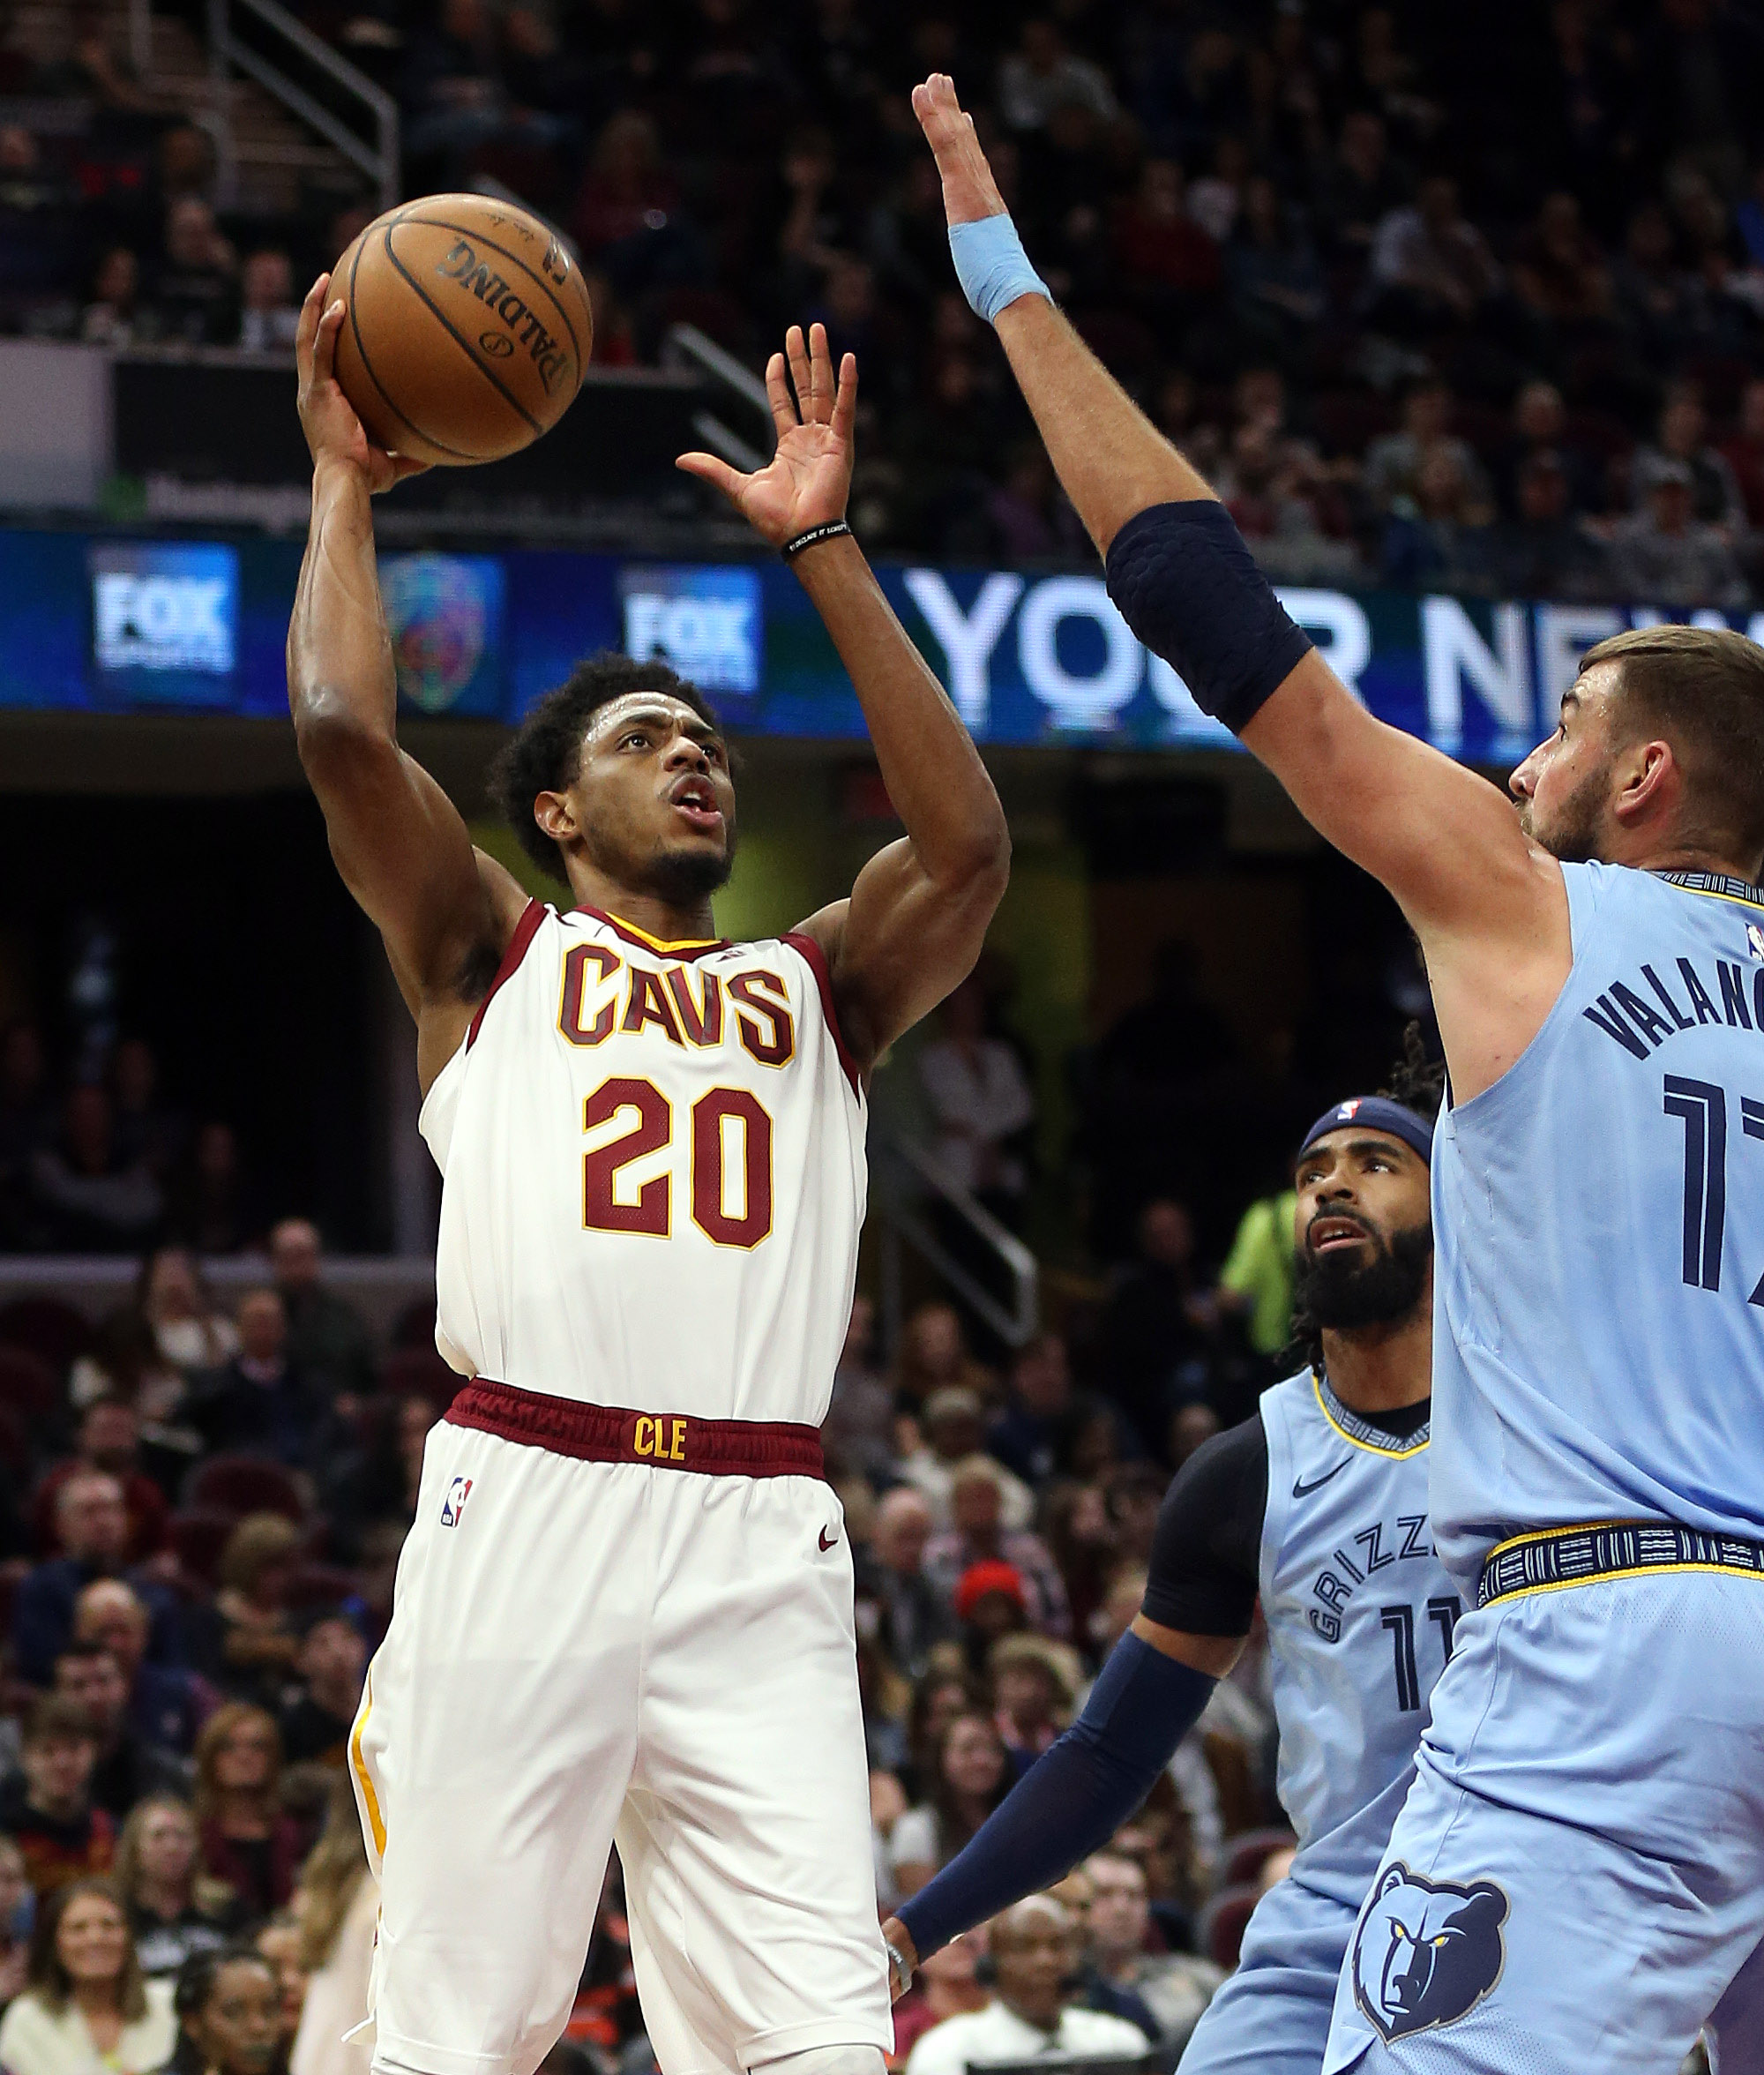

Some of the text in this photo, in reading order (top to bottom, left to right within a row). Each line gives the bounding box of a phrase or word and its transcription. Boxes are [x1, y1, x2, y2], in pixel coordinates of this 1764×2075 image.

[94, 573, 231, 644] FOX
[625, 593, 754, 664] FOX
[1421, 593, 1764, 739] NE
[557, 941, 796, 1070] CAVS
[581, 1074, 774, 1252] 20
[633, 1416, 688, 1462] CLE
[1309, 1514, 1439, 1644] GRIZZ
[1379, 1595, 1463, 1712] 11
